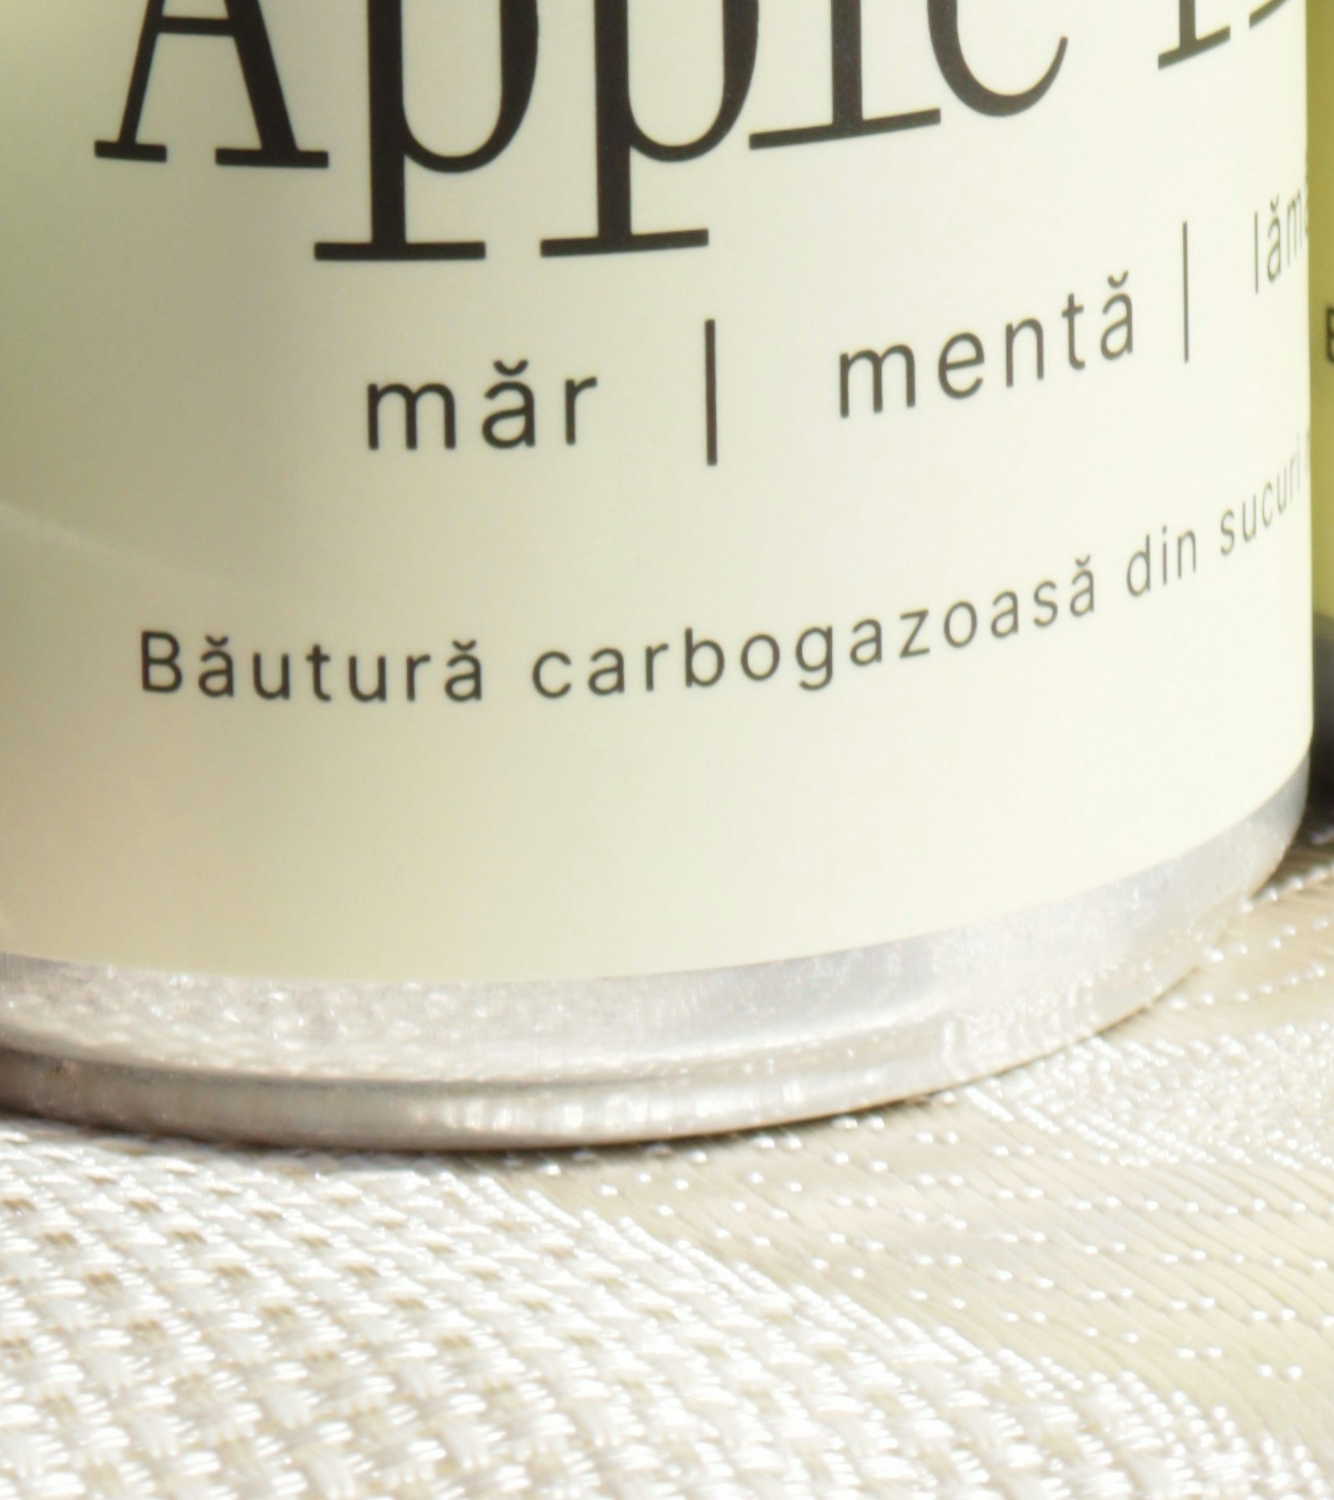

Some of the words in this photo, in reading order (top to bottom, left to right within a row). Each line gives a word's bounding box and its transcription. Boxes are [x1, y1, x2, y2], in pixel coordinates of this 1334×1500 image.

[365, 357, 599, 451] măr
[838, 270, 1135, 419] mentă
[1253, 188, 1308, 296] lăm
[138, 627, 485, 703] Băutură
[532, 554, 1097, 700] carbogazoasă
[1125, 525, 1197, 600] din
[1219, 432, 1302, 558] sucuri
